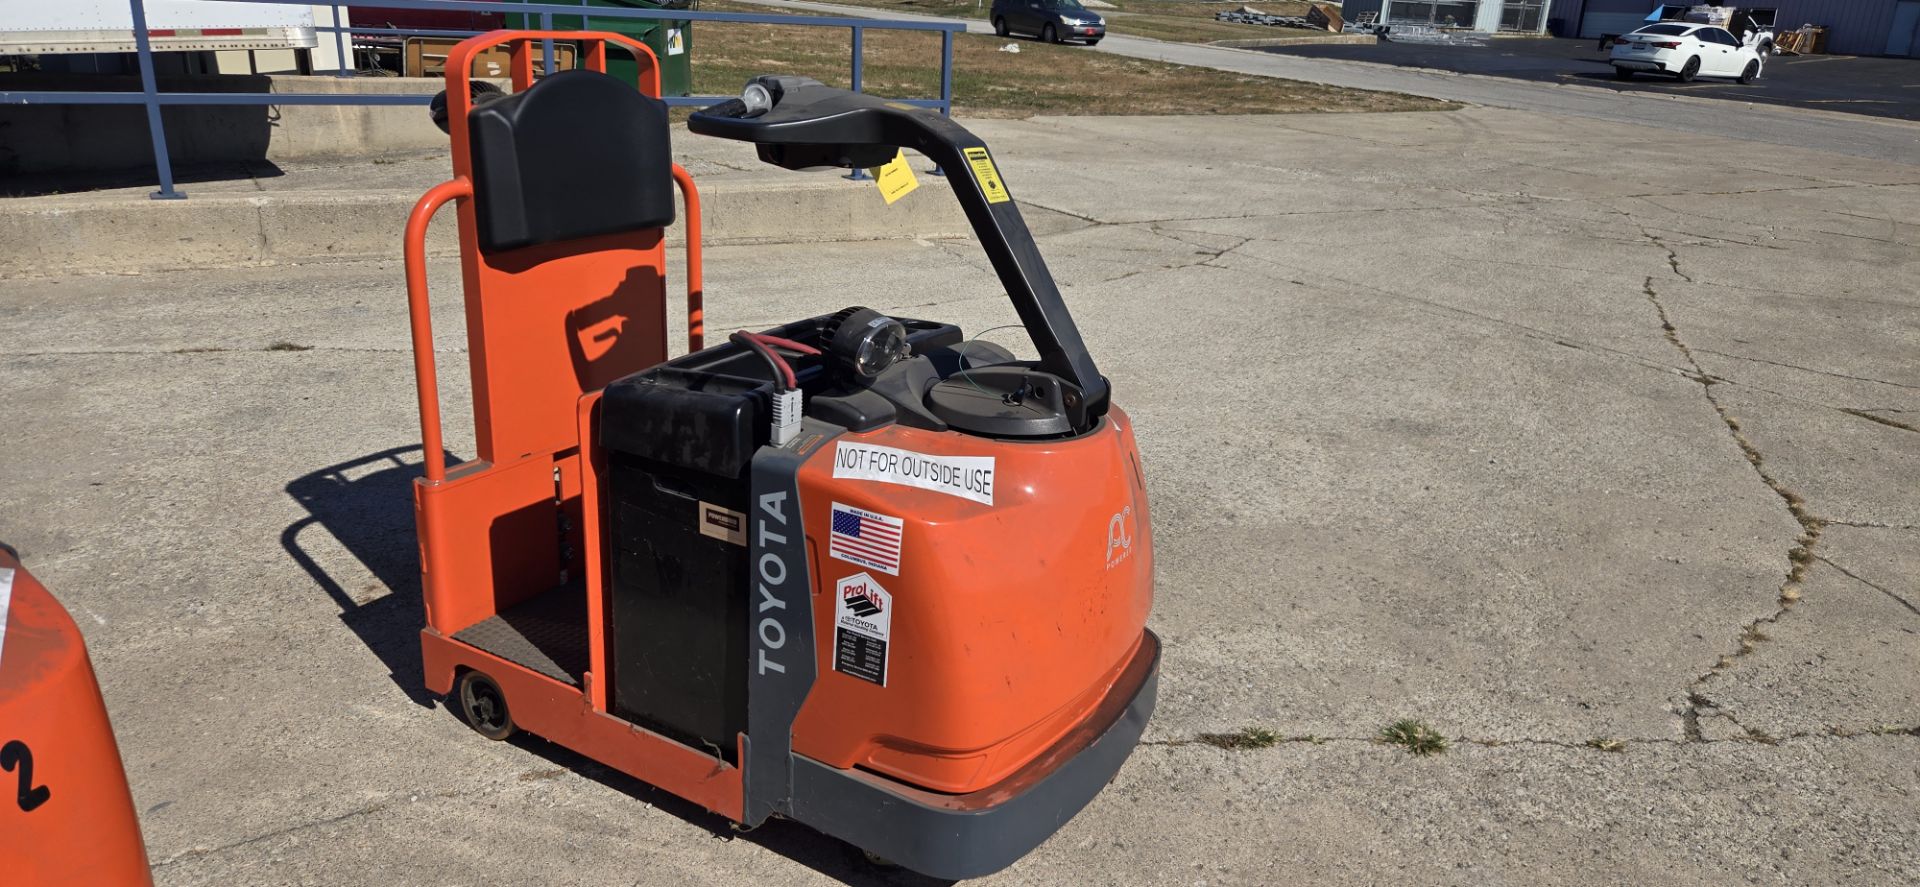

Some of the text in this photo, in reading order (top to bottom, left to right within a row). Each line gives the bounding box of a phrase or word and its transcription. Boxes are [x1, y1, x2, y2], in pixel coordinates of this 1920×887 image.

[835, 447, 992, 496] NOT FOR OUTSIDE USE
[850, 508, 863, 516] MADE
[840, 553, 887, 570] COLUMBUS, INDIANA
[758, 490, 787, 676] TOYOTA
[843, 582, 883, 612] ProLift
[852, 618, 878, 631] TOYOTA
[0, 739, 51, 813] 2
